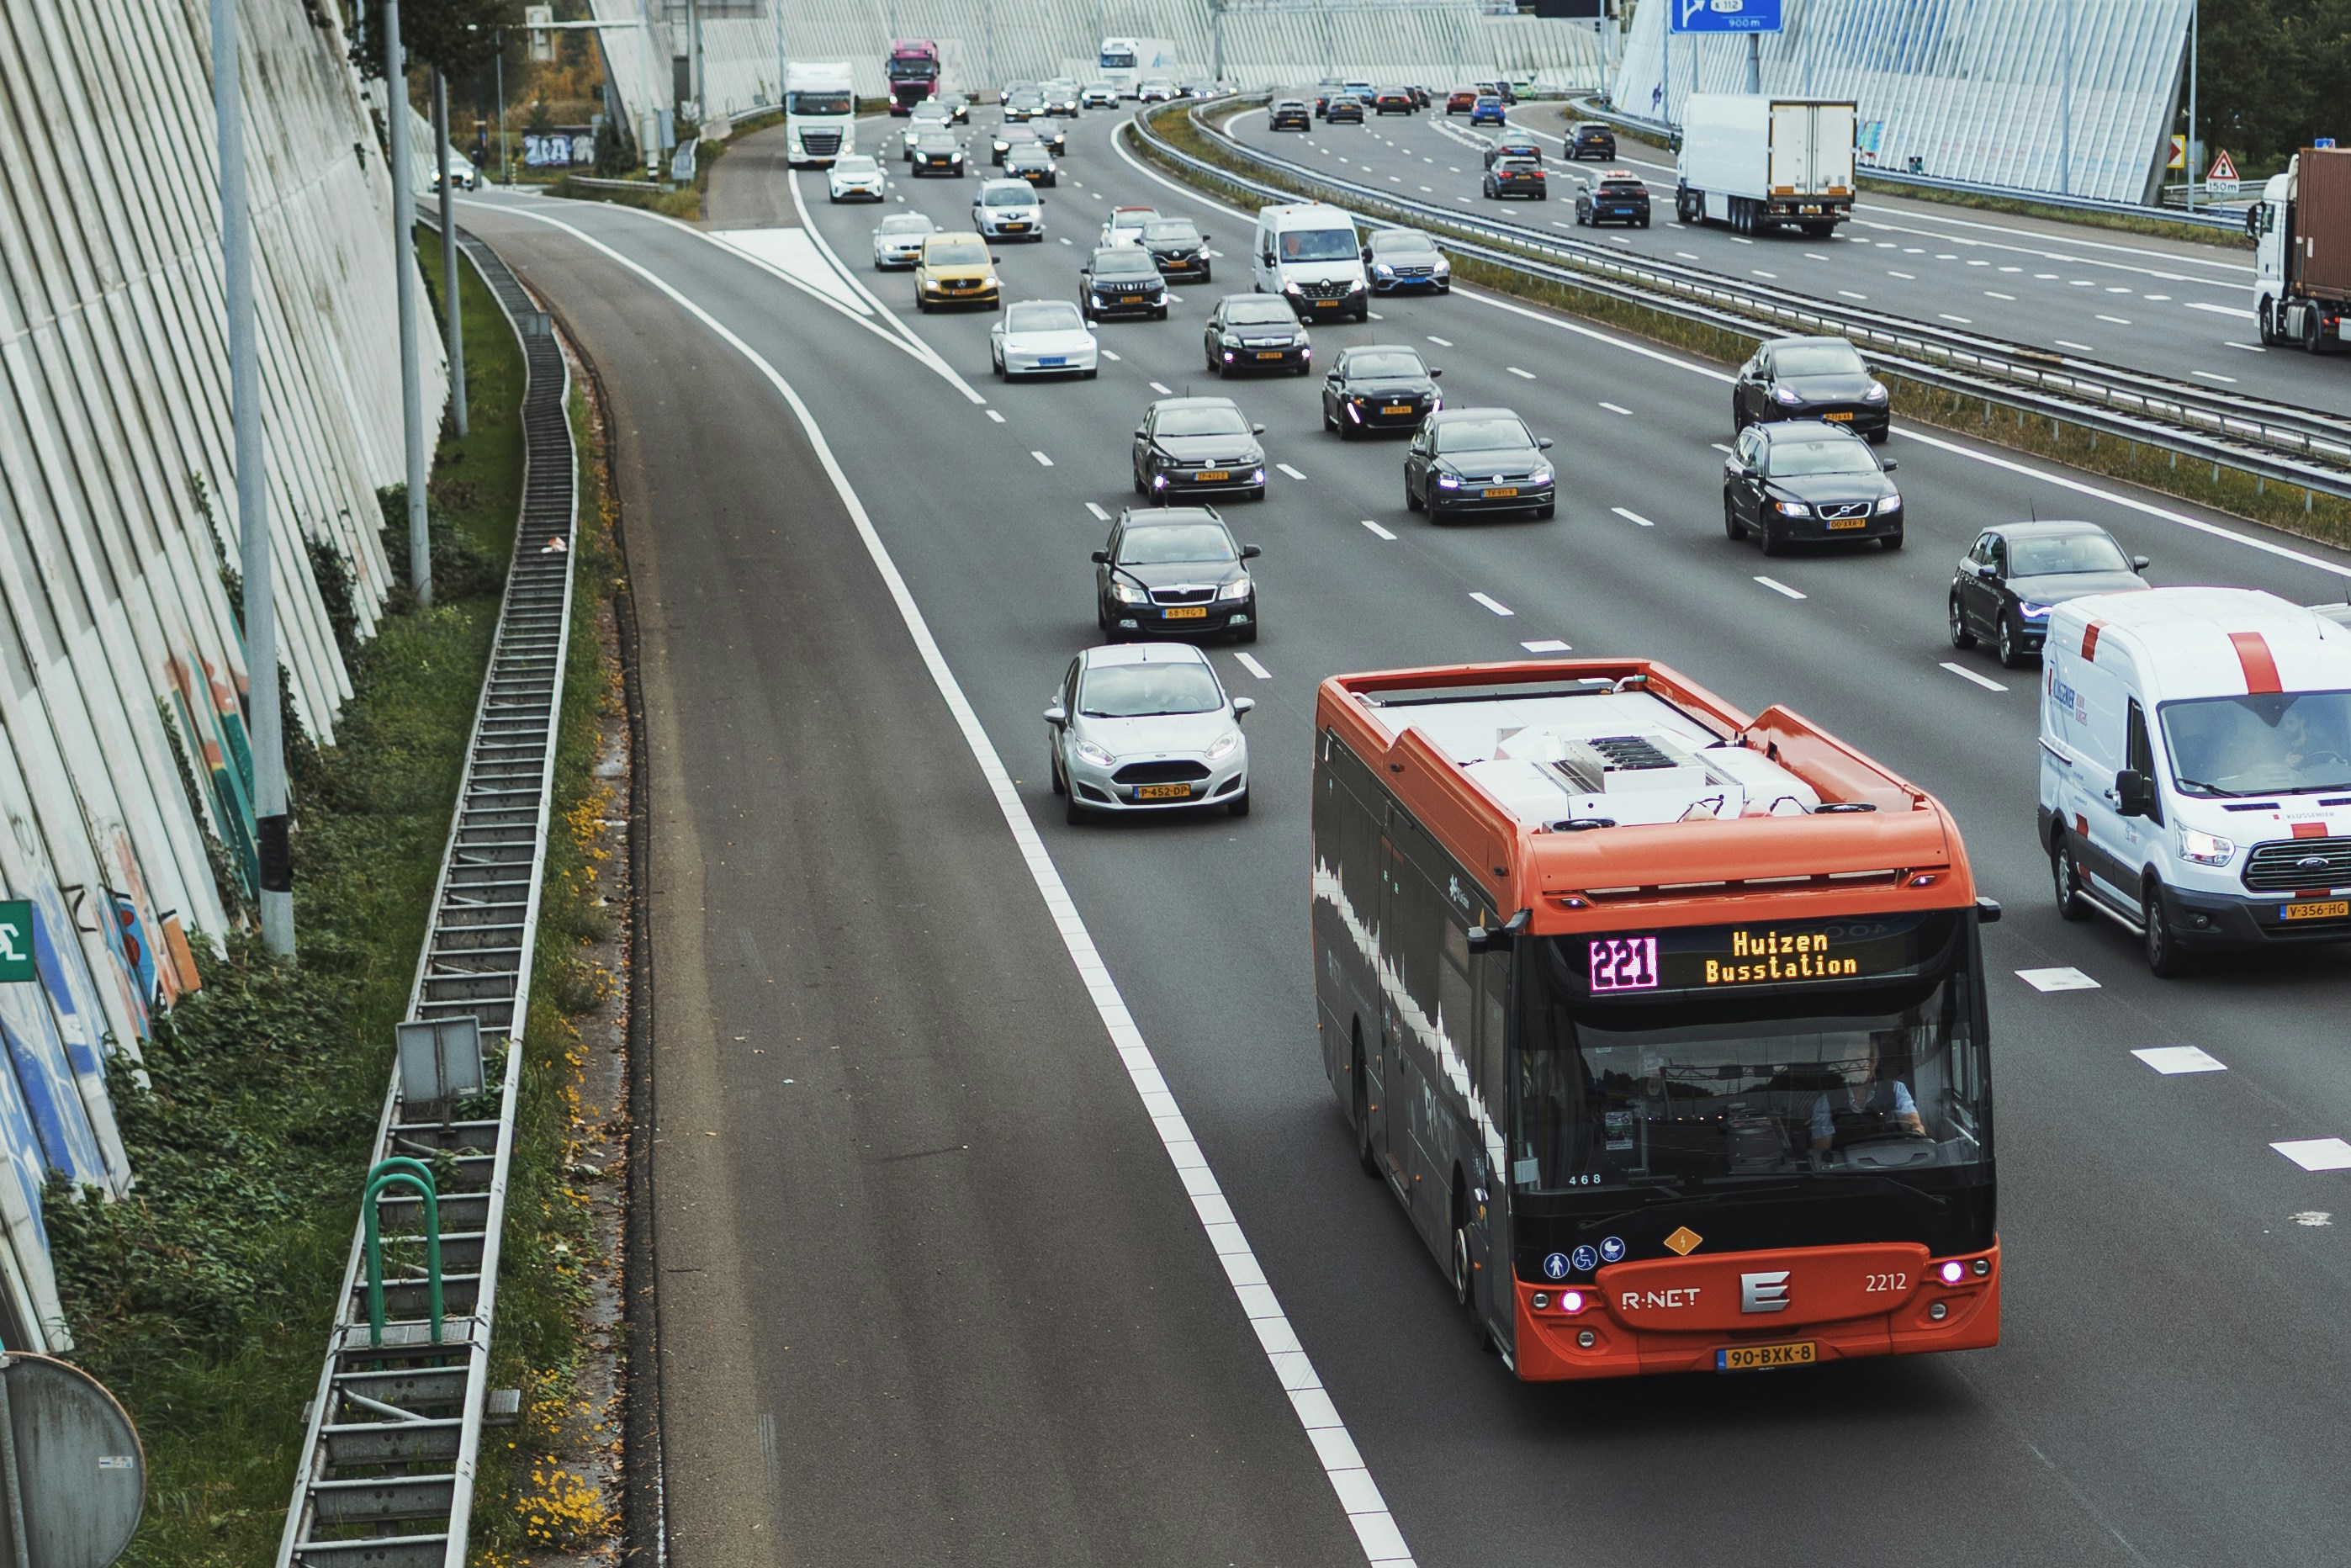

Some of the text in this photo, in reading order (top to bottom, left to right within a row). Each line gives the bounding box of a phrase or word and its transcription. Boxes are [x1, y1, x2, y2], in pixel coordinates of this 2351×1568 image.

[1724, 0, 1739, 9] 112
[1729, 19, 1749, 27] 900
[1168, 608, 1203, 617] 68-TFG-7
[1141, 786, 1188, 797] P-452-DP
[2290, 903, 2345, 918] V-356-HG
[1733, 931, 1829, 956] Huizen
[1592, 939, 1655, 988] 221
[1705, 953, 1858, 983] Busstation
[1866, 1273, 1906, 1292] 2212
[1731, 1345, 1811, 1366] 90-BXK-8
